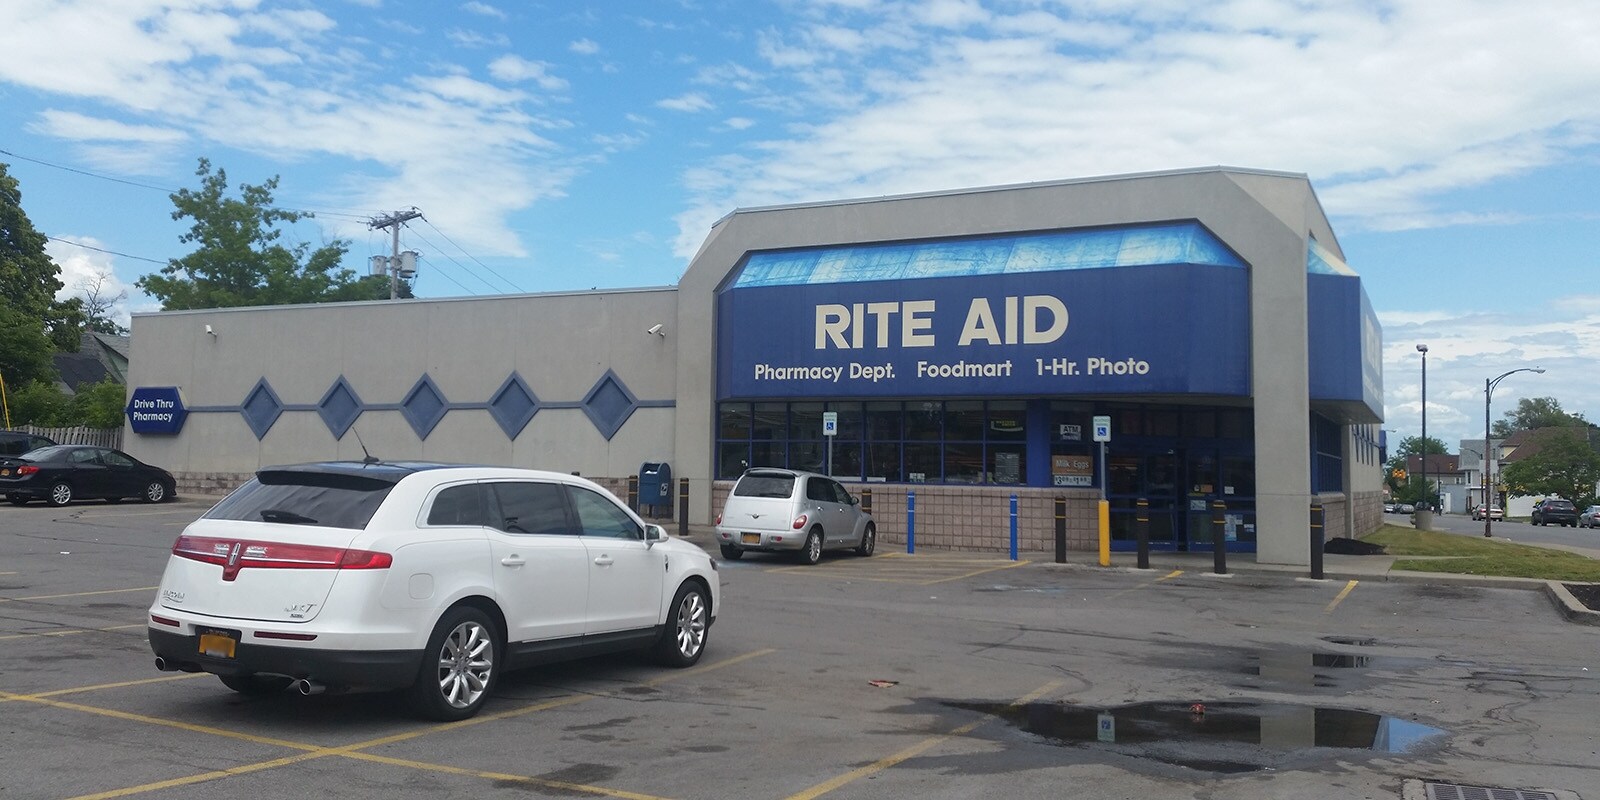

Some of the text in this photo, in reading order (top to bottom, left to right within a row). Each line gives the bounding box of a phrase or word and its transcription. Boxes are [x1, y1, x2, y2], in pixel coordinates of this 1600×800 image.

[815, 295, 1069, 349] RITE AID
[754, 362, 896, 383] Pharmacy Dept.
[917, 360, 1013, 378] Foodmart
[1035, 357, 1150, 377] 1-Hr. Photo
[135, 399, 173, 408] Drive Thru
[134, 411, 172, 422] Pharmacy
[1063, 425, 1079, 433] ATM
[1056, 459, 1089, 469] Milk Eggs
